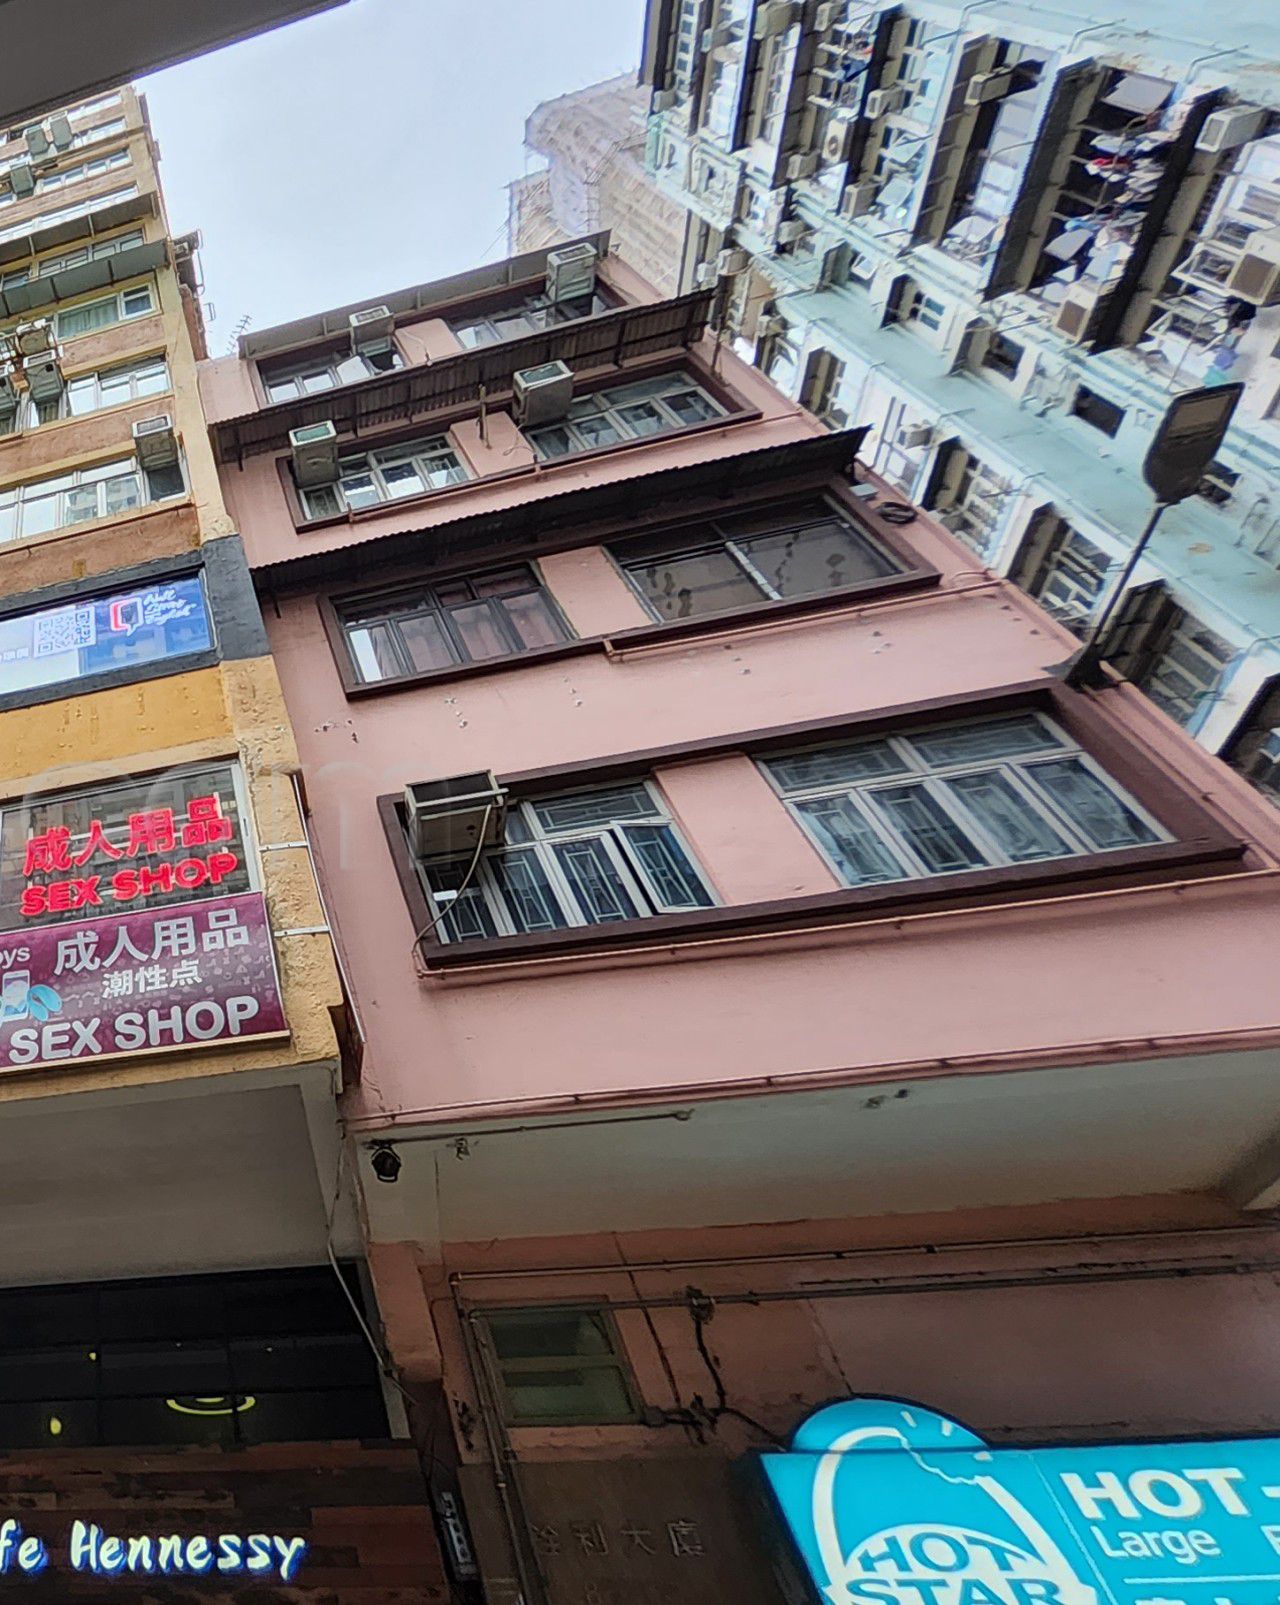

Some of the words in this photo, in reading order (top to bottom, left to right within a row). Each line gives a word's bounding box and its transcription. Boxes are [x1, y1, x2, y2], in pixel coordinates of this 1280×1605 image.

[21, 794, 233, 877] 成人用品
[20, 874, 104, 917] SEX
[111, 852, 239, 901] SHOP
[53, 908, 250, 976] 成人用品
[101, 960, 203, 999] 潮性点
[9, 1017, 104, 1066] SEX
[115, 995, 261, 1047] SHOP
[1059, 1467, 1251, 1520] HOT
[70, 1518, 306, 1581] Hennessy
[858, 1531, 1027, 1573] HOT
[1089, 1525, 1223, 1565] Large
[845, 1577, 1063, 1605] STAR
